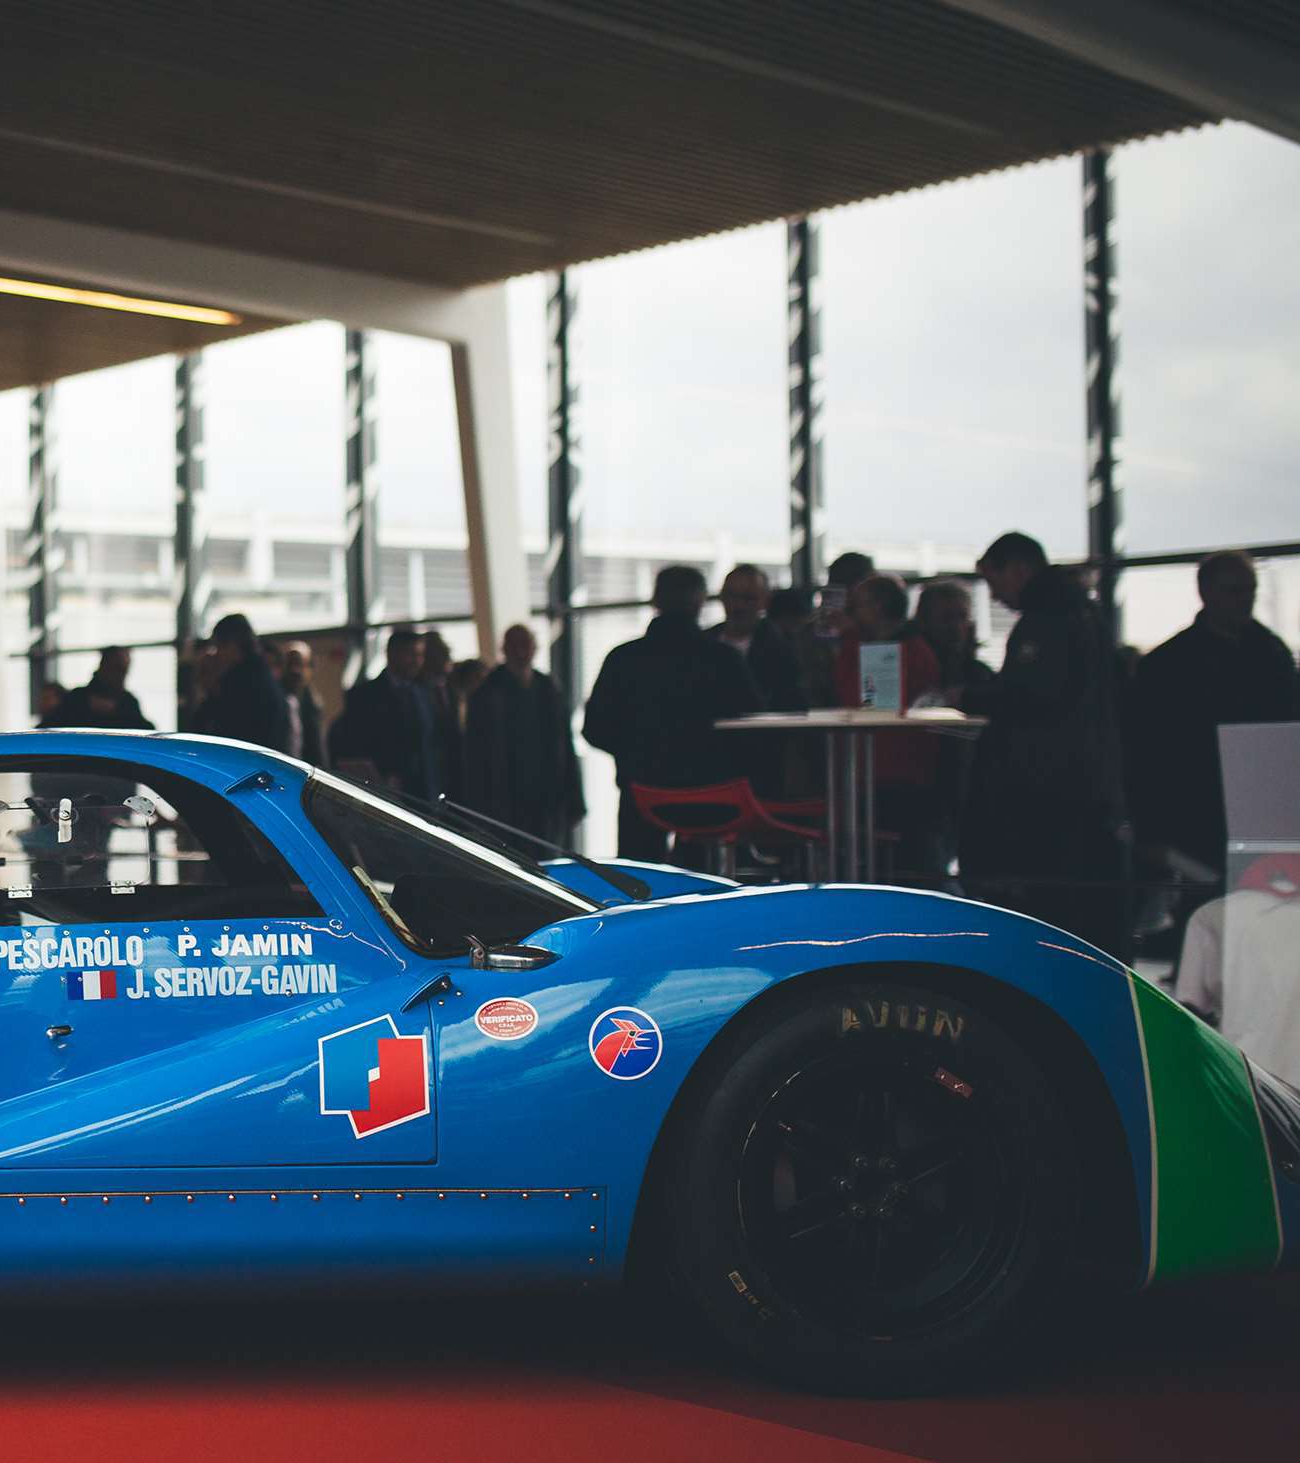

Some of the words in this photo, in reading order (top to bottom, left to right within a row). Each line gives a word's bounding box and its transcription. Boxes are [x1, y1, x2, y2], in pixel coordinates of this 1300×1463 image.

[177, 934, 201, 957] P.
[211, 933, 314, 957] JAMIN
[126, 973, 150, 999] J.
[154, 964, 338, 997] SERVOZ-GAVIN
[480, 1014, 533, 1024] VERIFICATO
